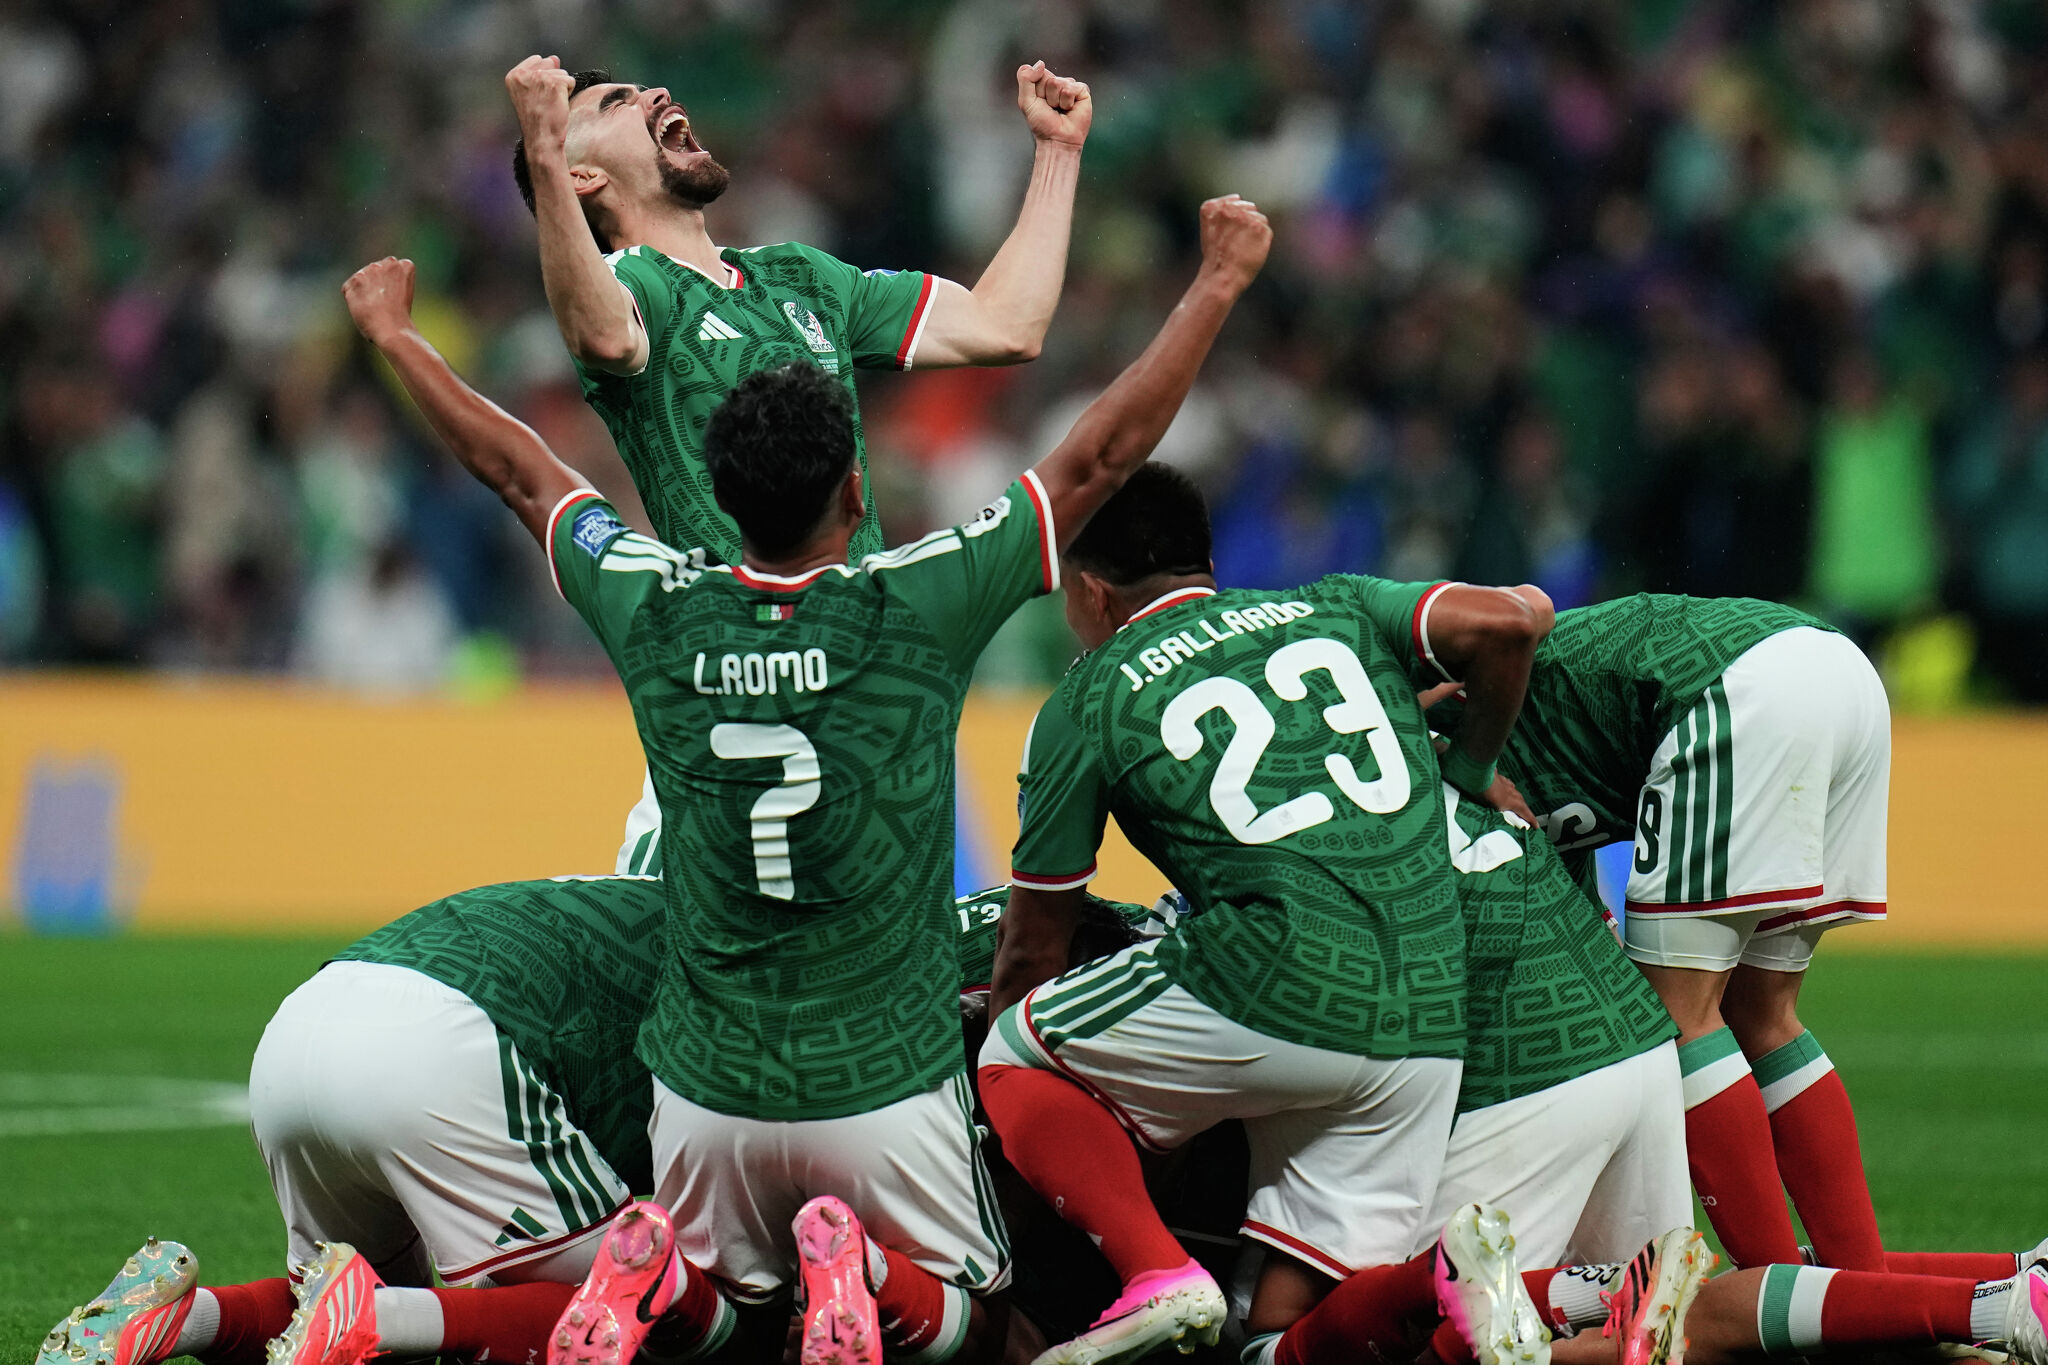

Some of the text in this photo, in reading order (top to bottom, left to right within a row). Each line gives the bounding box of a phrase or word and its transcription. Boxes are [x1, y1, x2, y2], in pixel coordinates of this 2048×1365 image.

[693, 647, 829, 696] L.ROMO
[1120, 601, 1315, 692] J.GALLARDO
[1160, 637, 1409, 845] 23
[709, 722, 822, 901] 7
[1972, 1281, 2016, 1300] EDESIGN
